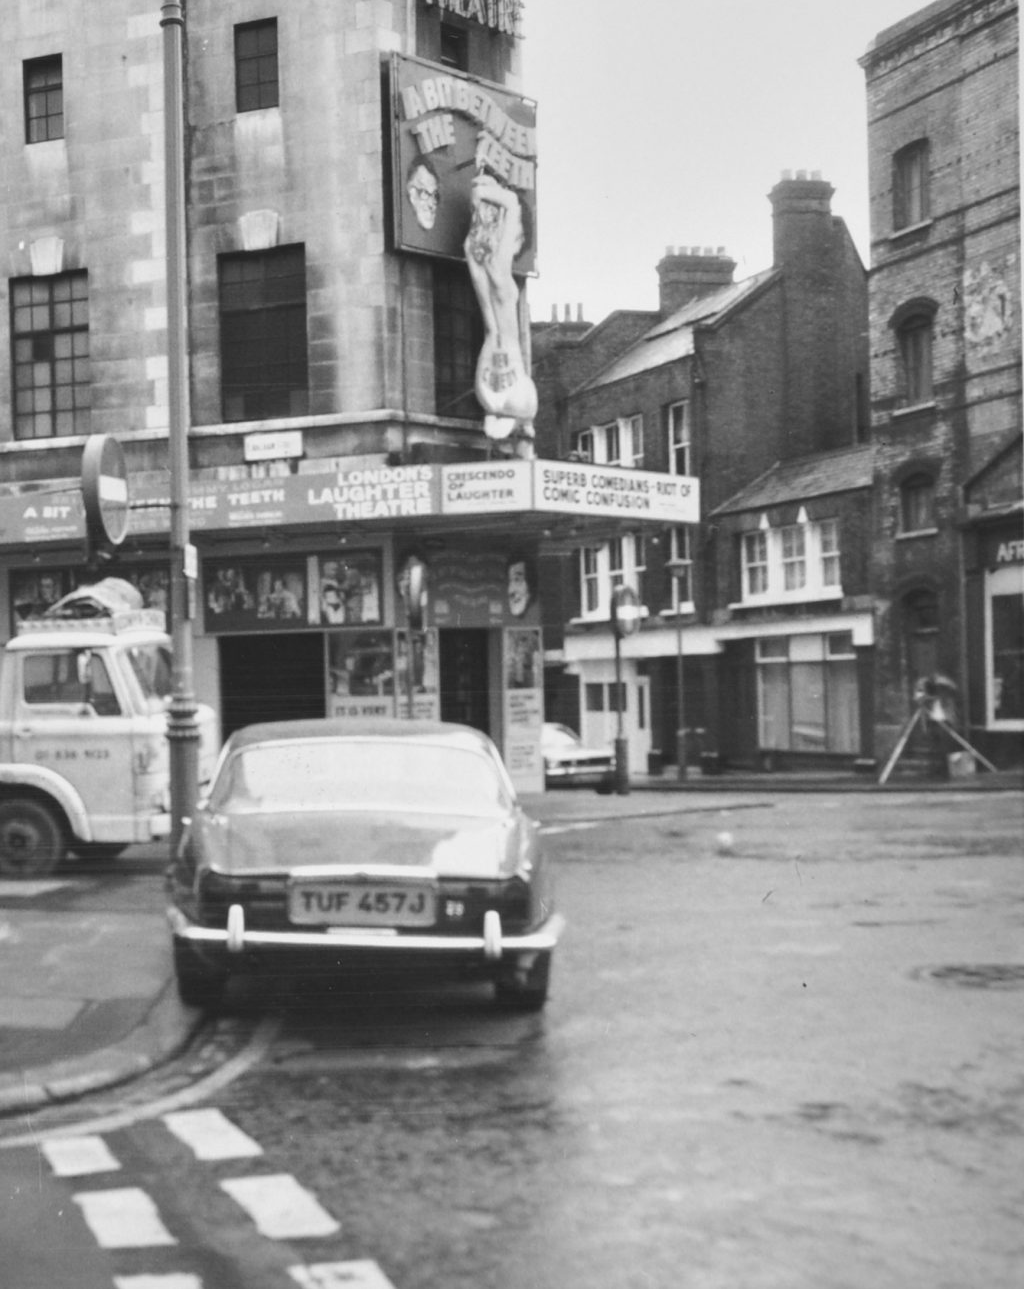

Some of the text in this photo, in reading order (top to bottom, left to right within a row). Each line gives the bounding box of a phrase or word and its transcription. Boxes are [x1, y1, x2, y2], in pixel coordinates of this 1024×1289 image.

[402, 85, 426, 119] A
[422, 77, 454, 111] BIT
[416, 114, 456, 153] THE
[447, 469, 515, 481] CRESCENDO
[543, 469, 587, 488] SUPERB
[591, 474, 650, 493] COMEDIANS
[680, 484, 691, 498] OF
[227, 489, 285, 506] TEETH
[308, 481, 430, 505] LAUGHTER
[447, 489, 514, 502] LAUGHTER
[448, 482, 464, 491] OF
[334, 498, 431, 520] THEATRE
[543, 486, 650, 510] COMIC CONFUSION
[22, 506, 71, 519] A BIT
[301, 891, 425, 914] TUF 457J
